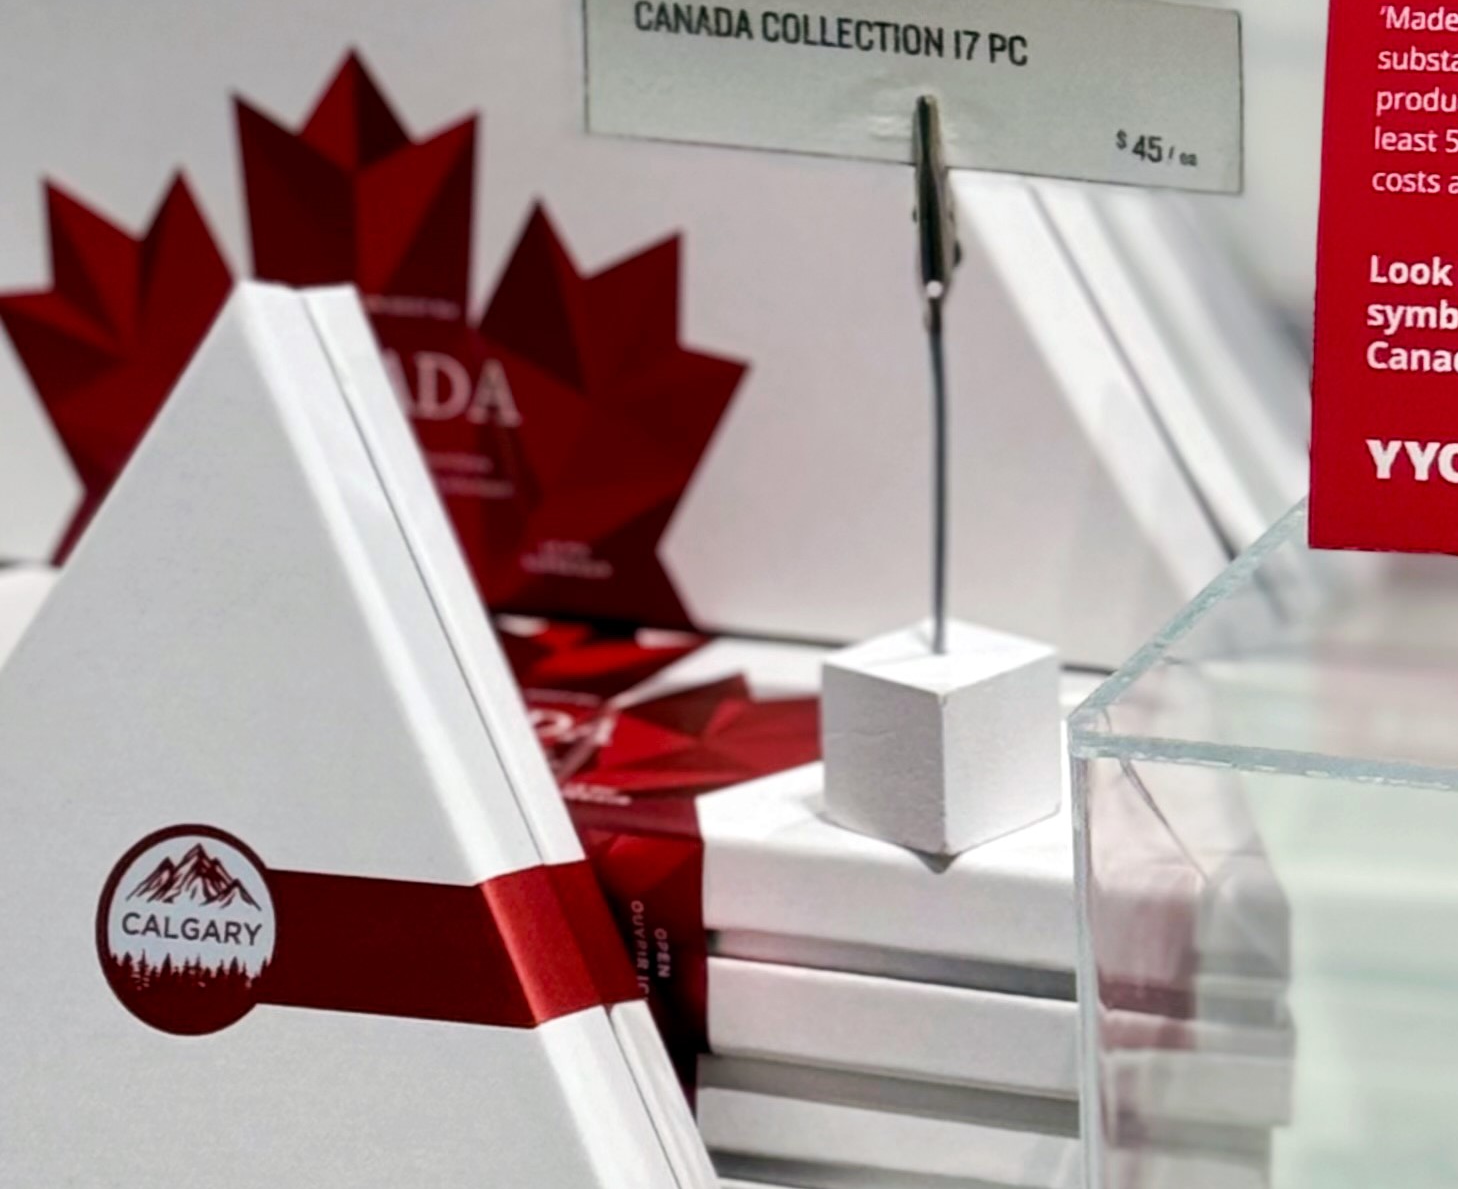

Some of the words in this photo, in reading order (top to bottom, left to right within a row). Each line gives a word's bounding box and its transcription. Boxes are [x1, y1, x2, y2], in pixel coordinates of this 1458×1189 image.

[634, 0, 754, 40] CANADA
[761, 11, 944, 58] COLLECTION
[953, 29, 981, 61] 17
[988, 33, 1029, 66] PC
[1375, 126, 1438, 153] least
[1372, 171, 1441, 193] costs
[1370, 254, 1453, 287] Look
[121, 911, 263, 946] CALGARY
[653, 927, 671, 978] OPEN
